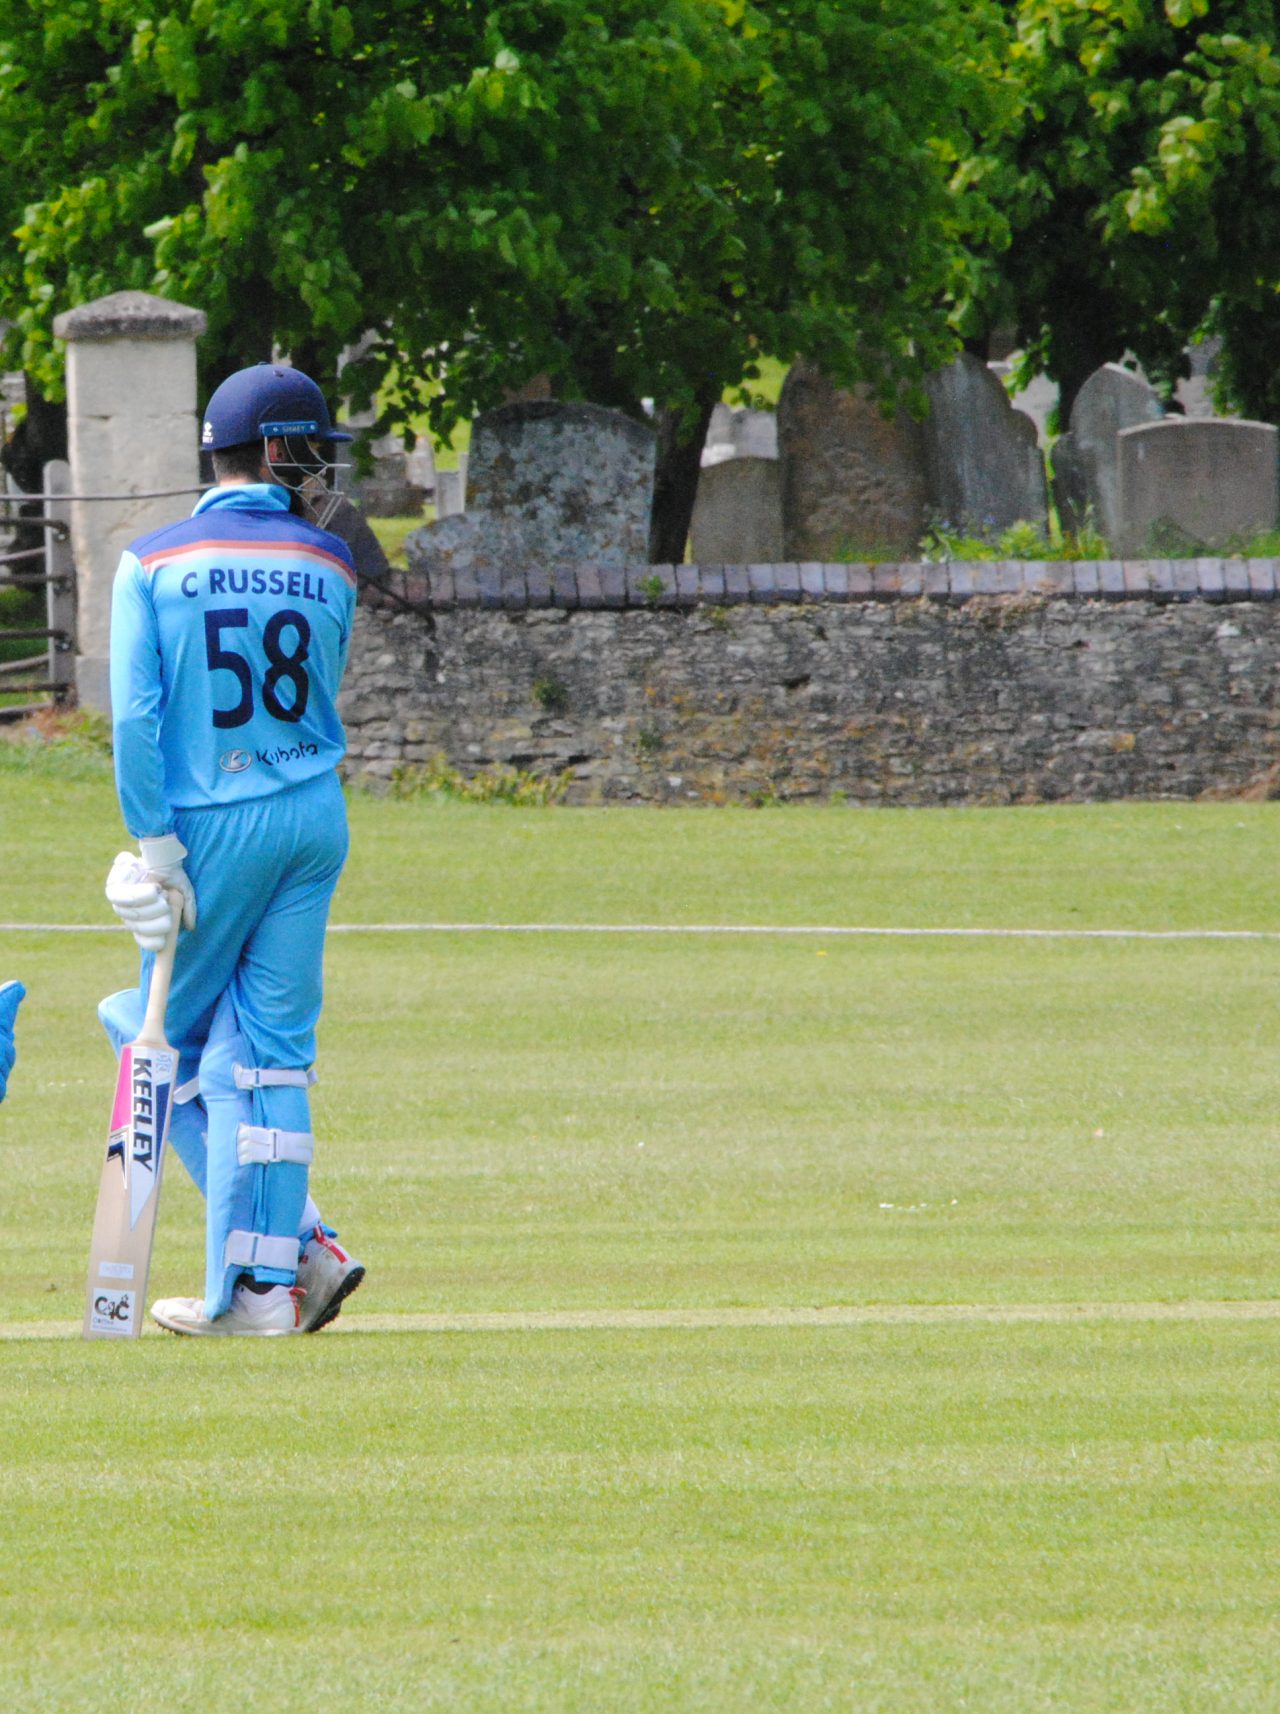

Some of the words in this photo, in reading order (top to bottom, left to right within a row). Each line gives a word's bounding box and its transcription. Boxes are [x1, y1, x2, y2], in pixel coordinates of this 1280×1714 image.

[181, 571, 198, 598] C
[209, 568, 328, 604] RUSSELL
[204, 607, 311, 729] 58
[255, 741, 319, 766] Kubota
[133, 1057, 153, 1173] KEELEY
